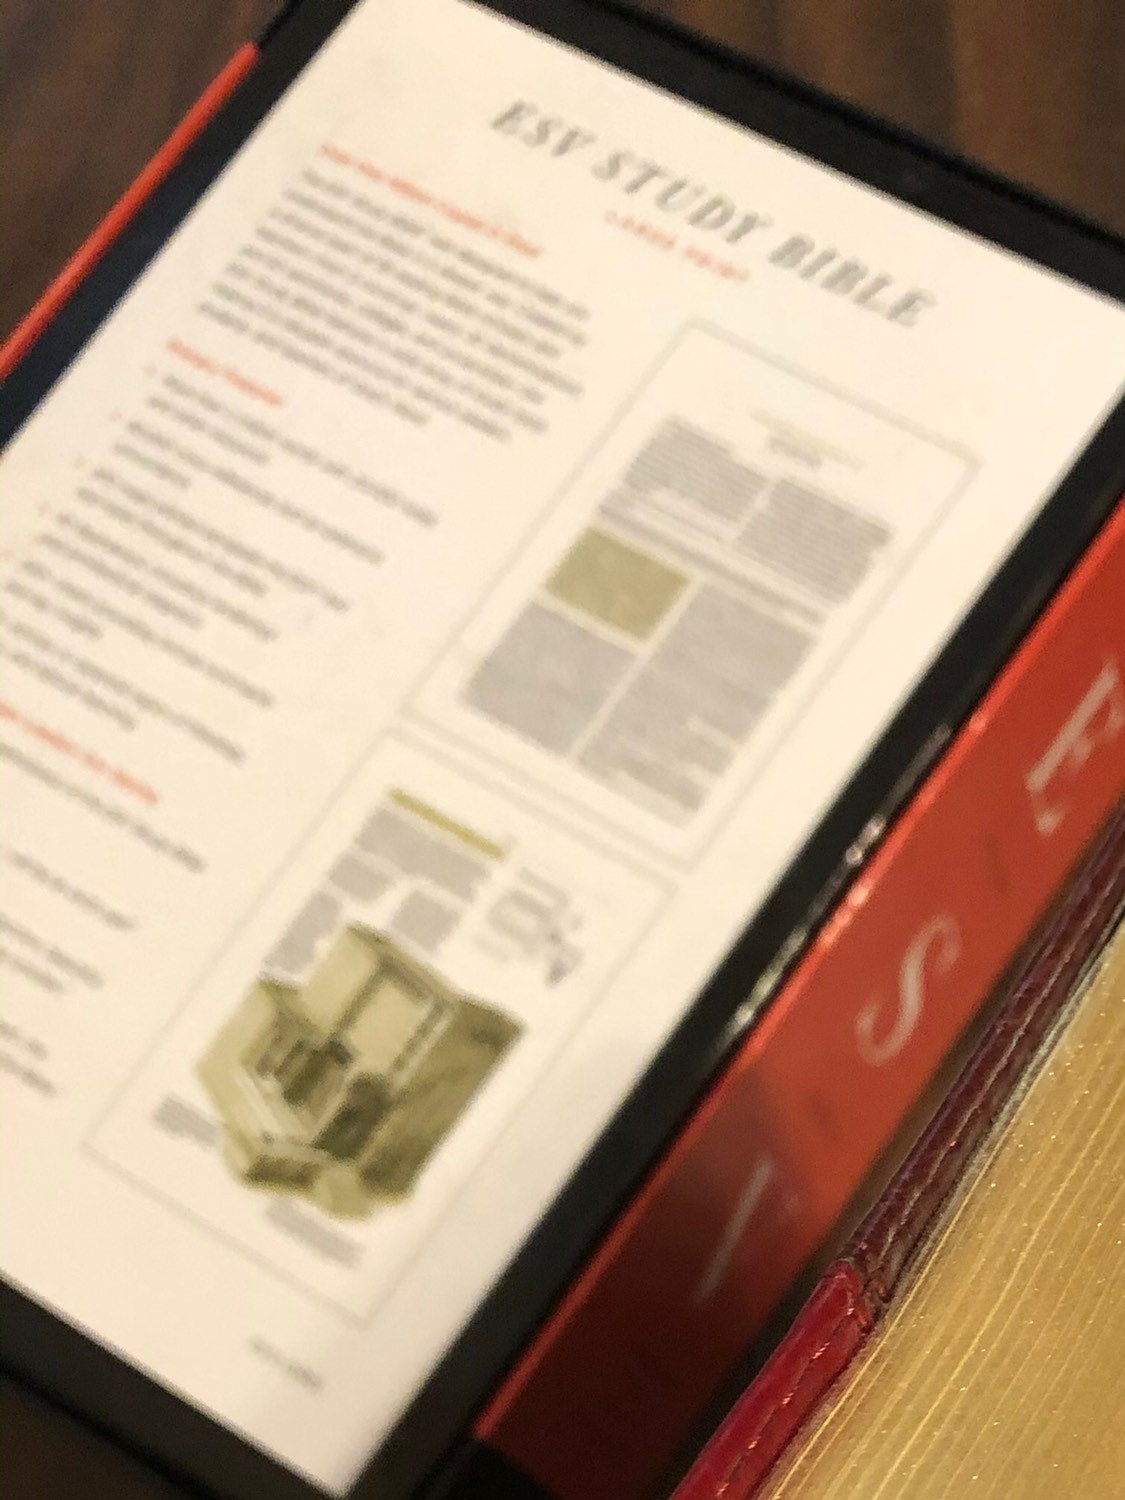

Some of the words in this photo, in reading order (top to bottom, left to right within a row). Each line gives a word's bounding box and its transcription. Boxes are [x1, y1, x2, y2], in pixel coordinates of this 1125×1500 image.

[488, 99, 597, 159] ESV
[591, 149, 773, 245] STUDY
[767, 233, 938, 328] BIBLE
